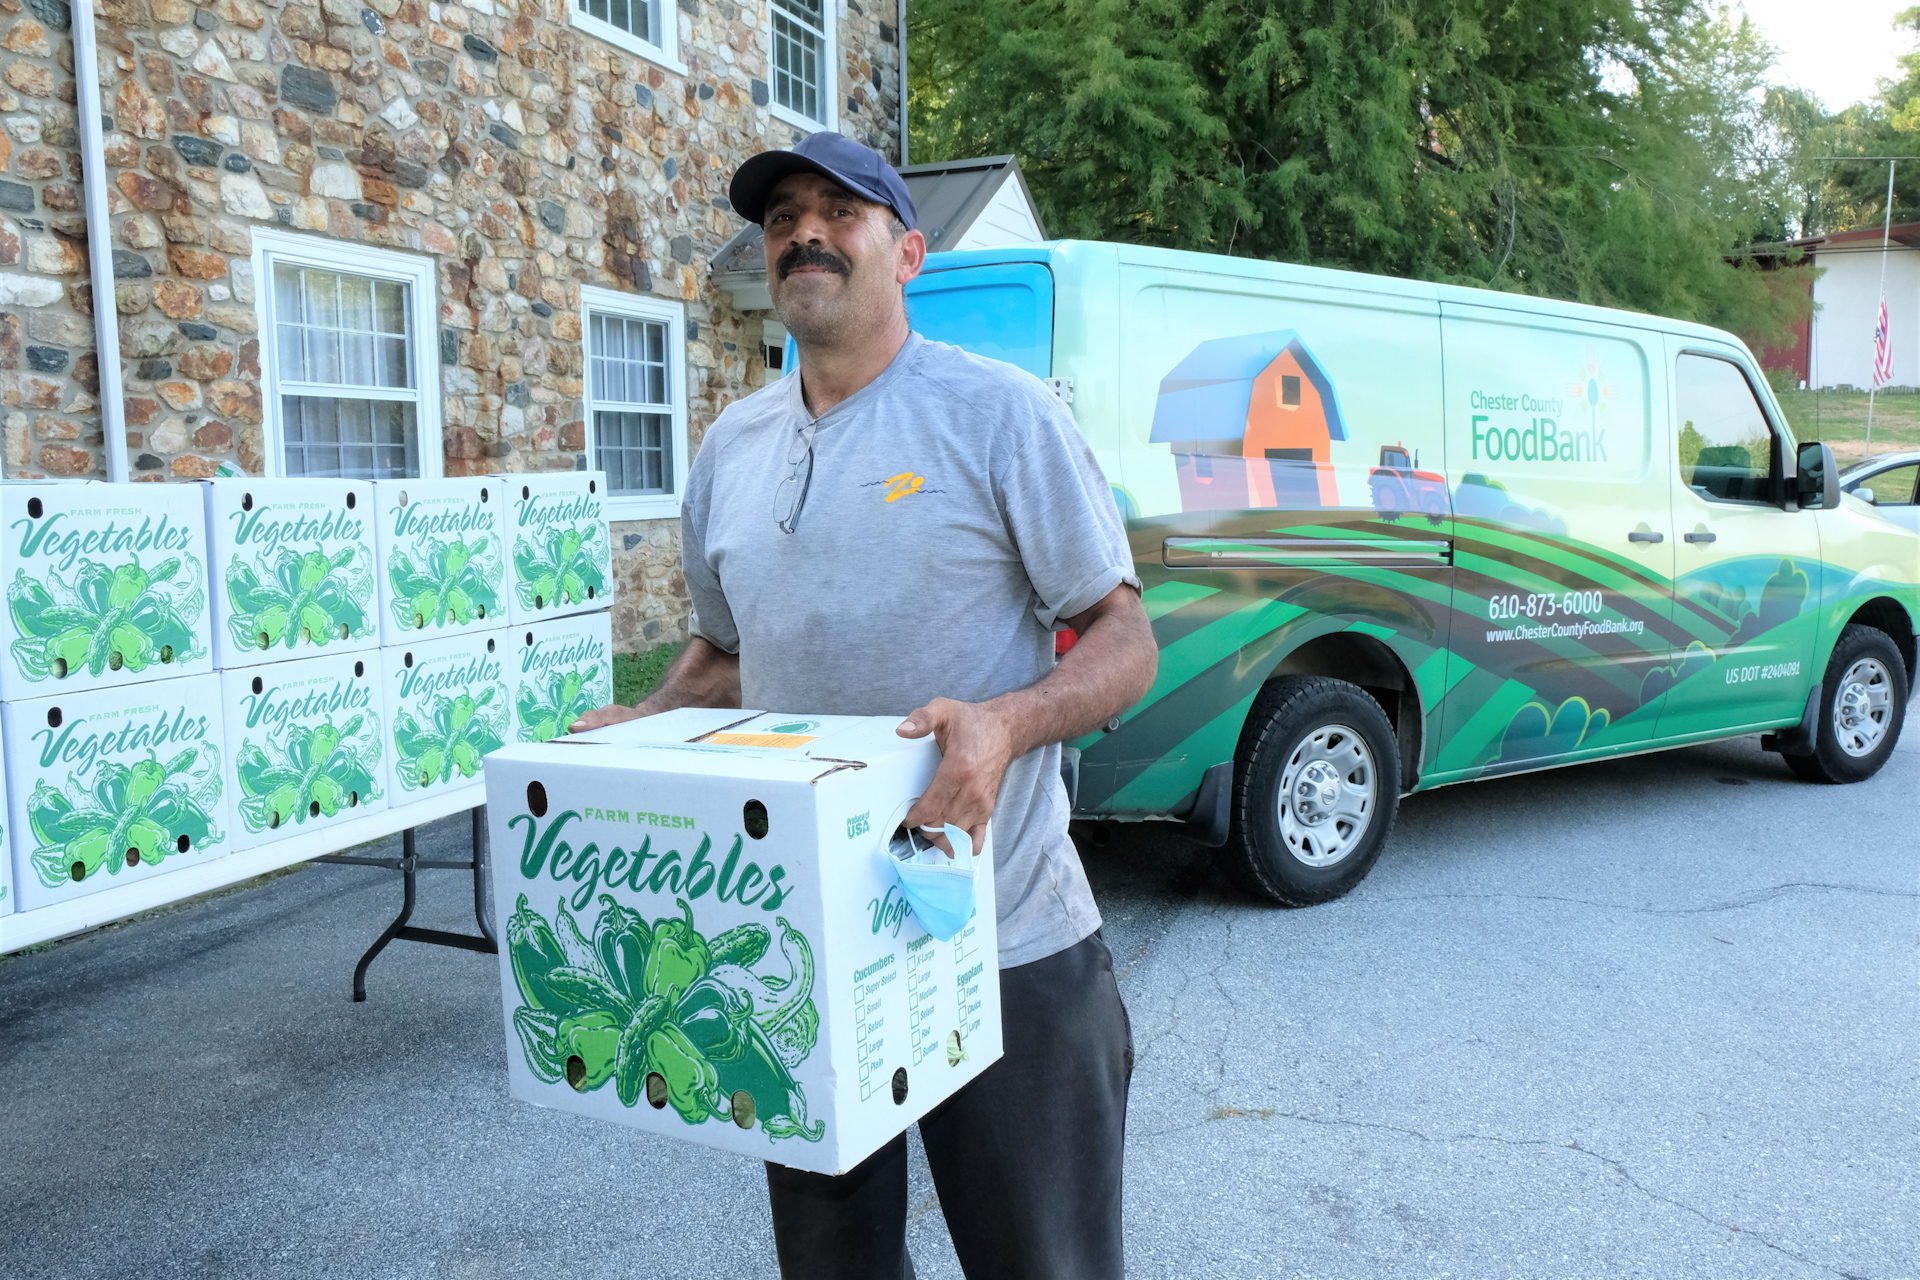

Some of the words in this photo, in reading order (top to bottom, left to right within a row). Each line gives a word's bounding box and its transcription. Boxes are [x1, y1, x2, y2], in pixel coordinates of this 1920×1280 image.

[1470, 390, 1519, 411] Chester
[1521, 394, 1563, 418] County
[1472, 415, 1608, 462] FoodBank
[70, 508, 101, 516] FARM
[514, 492, 603, 536] Vegetables
[229, 506, 365, 557] Vegetables
[389, 501, 496, 547] Vegetables
[10, 513, 193, 571] Vegetables
[1489, 591, 1602, 620] 610-873-6000
[1486, 618, 1644, 642] www.ChesterCountyFoodBank.org
[428, 655, 447, 664] FARM
[449, 652, 471, 660] FRESH
[518, 634, 605, 680] Vegetables
[282, 680, 305, 690] FARM
[307, 676, 335, 685] FRESH
[395, 653, 503, 706] Vegetables
[1725, 668, 1739, 684] US
[1741, 666, 1760, 682] DOT
[89, 711, 120, 722] FARM
[124, 704, 159, 716] FRESH
[240, 677, 373, 737] Vegetables
[30, 705, 211, 776] Vegetables
[584, 808, 630, 824] FARM
[636, 811, 696, 830] FRESH
[847, 820, 870, 840] USA
[508, 809, 794, 912] Vegetables
[906, 932, 934, 954] Peppers
[853, 953, 895, 984] Cucumbers
[917, 970, 931, 984] Large
[957, 961, 984, 987] Eggplant
[865, 979, 881, 996] Super
[881, 970, 897, 987] Select
[918, 985, 938, 1002] Medium
[966, 984, 979, 997] Fancy
[866, 998, 882, 1015] Small
[920, 1004, 935, 1021] Select
[967, 1000, 982, 1015] Choice
[867, 1017, 884, 1034] Select
[921, 1026, 931, 1039] Red
[969, 1019, 981, 1033] Large
[869, 1038, 884, 1054] Large
[870, 1057, 884, 1073] Plain
